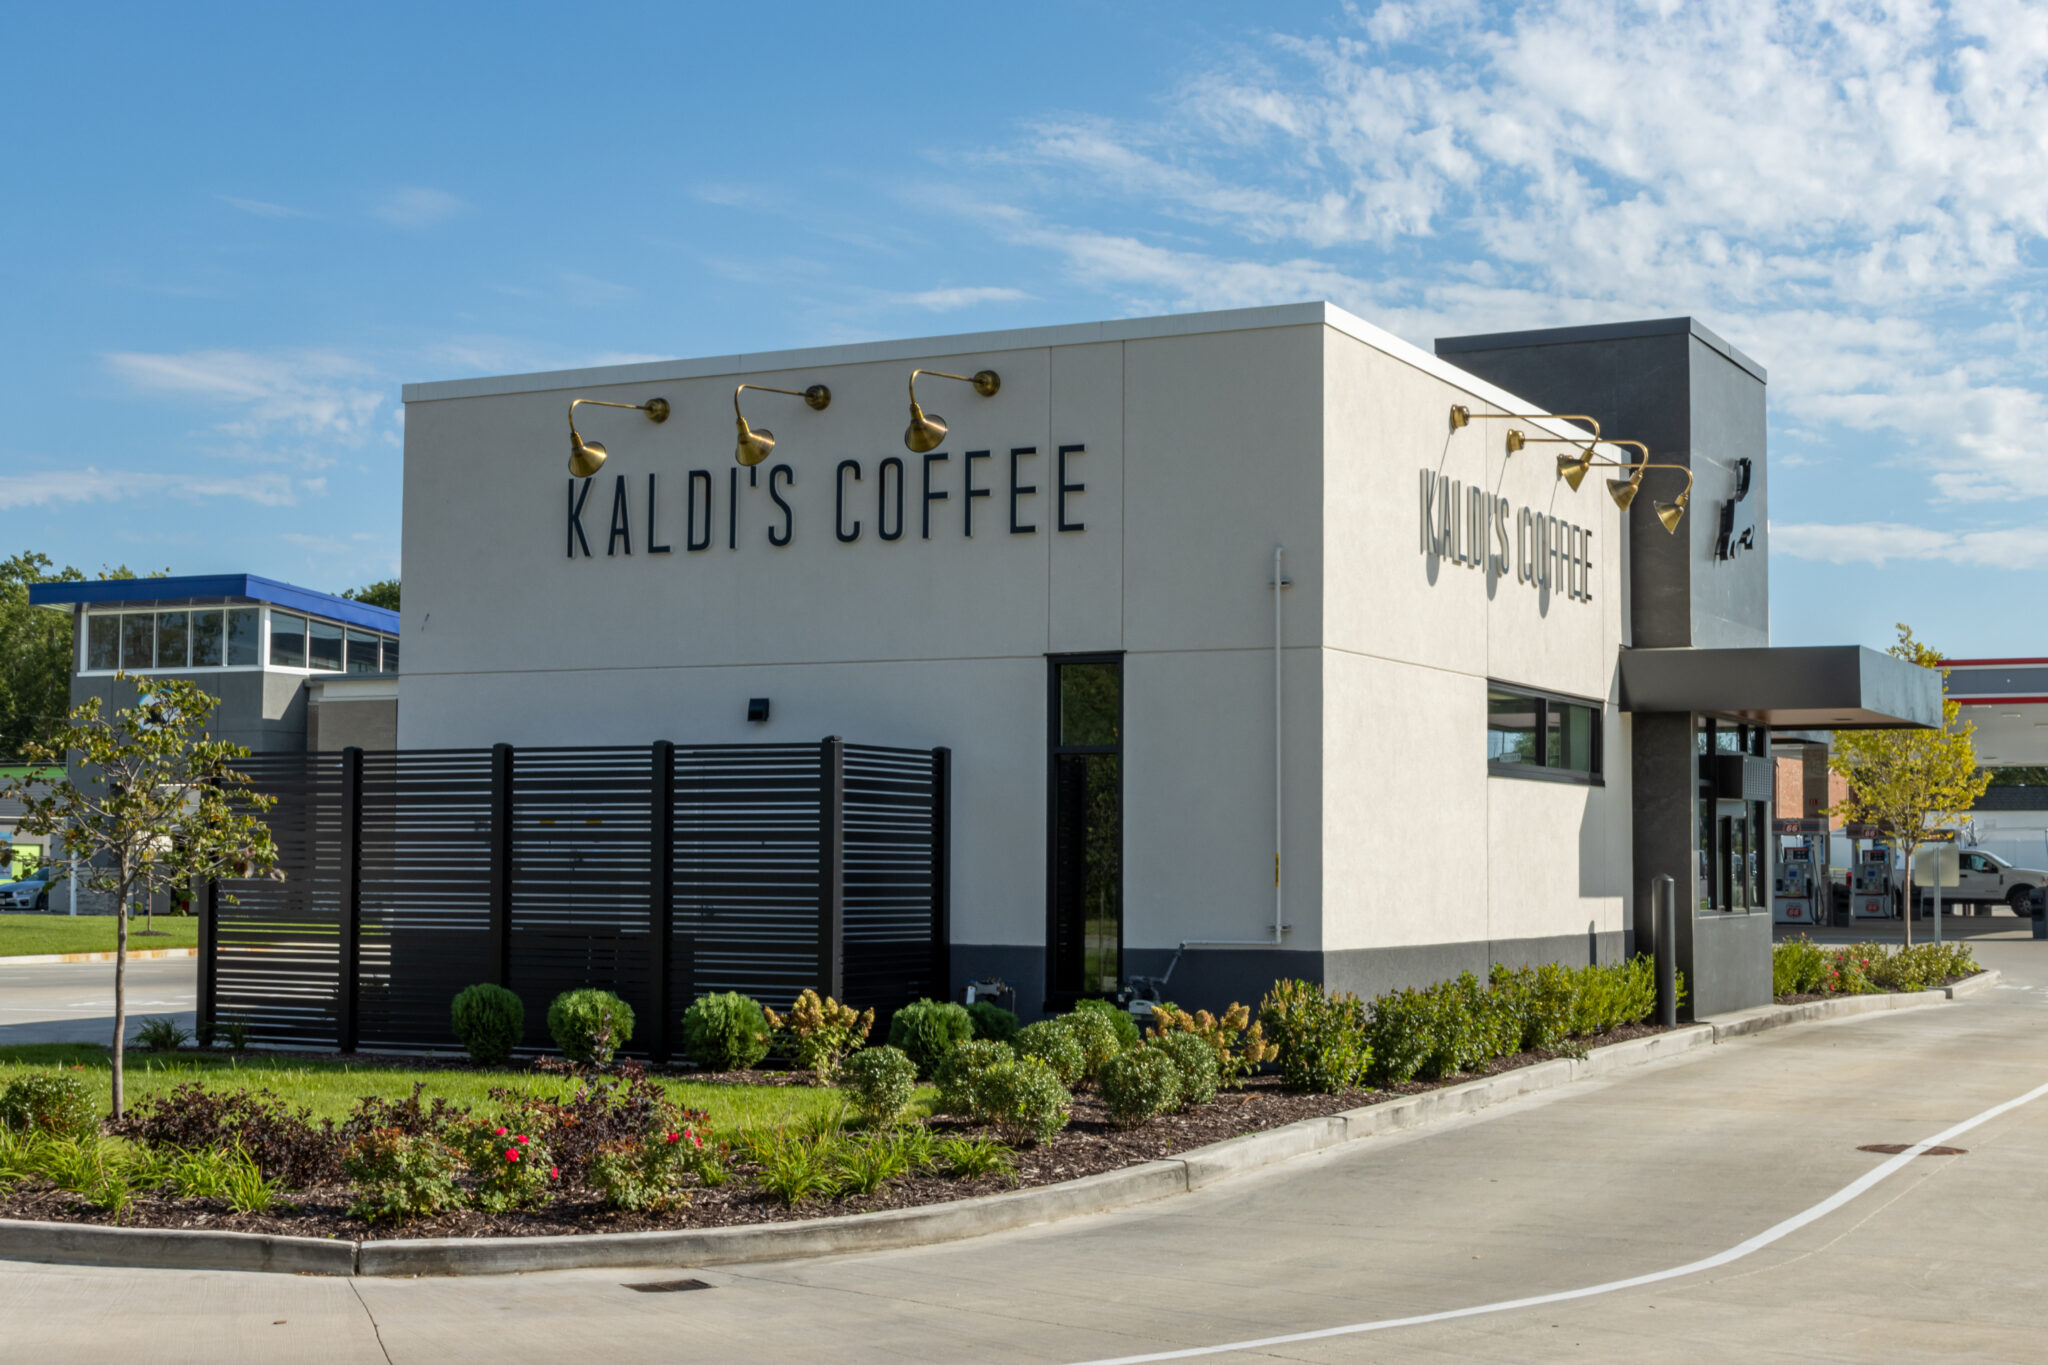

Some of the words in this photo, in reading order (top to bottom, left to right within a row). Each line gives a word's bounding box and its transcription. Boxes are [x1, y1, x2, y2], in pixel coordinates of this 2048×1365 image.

[567, 463, 795, 558] KALDI'S
[835, 443, 1087, 543] COFFEE
[1420, 468, 1510, 575] KALDI'S
[1517, 506, 1593, 602] COFFEE
[1785, 823, 1798, 833] 66
